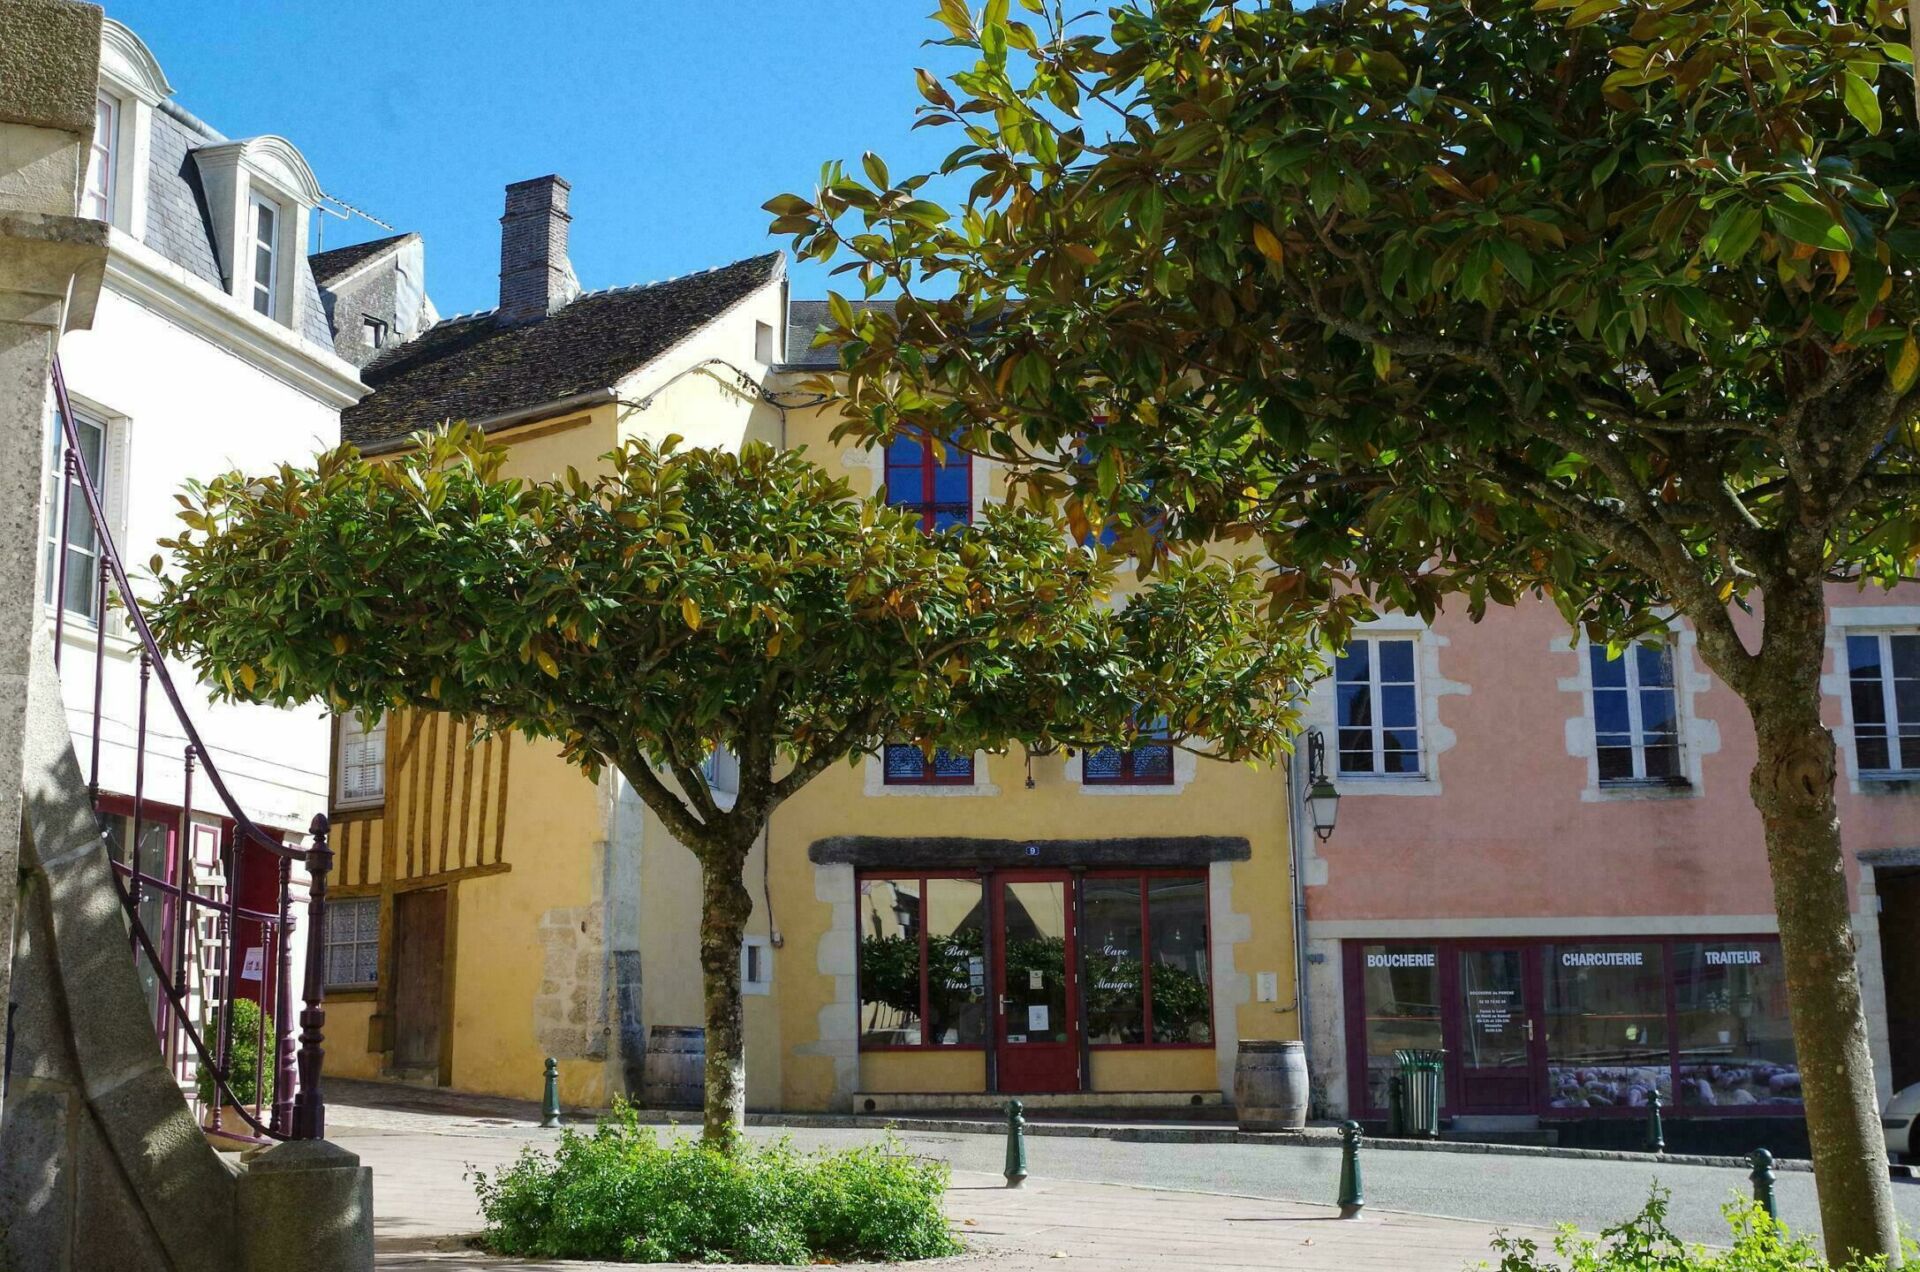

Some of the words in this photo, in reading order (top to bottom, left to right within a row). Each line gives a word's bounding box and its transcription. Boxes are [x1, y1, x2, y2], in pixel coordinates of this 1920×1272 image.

[944, 944, 970, 956] Bar
[1103, 944, 1128, 956] Cave
[1367, 953, 1435, 967] BOUCHERIE
[1562, 952, 1643, 966] CHARCUTERIE
[1704, 950, 1761, 965] TRAITEUR
[944, 978, 969, 989] Vins
[1094, 977, 1133, 993] Manger
